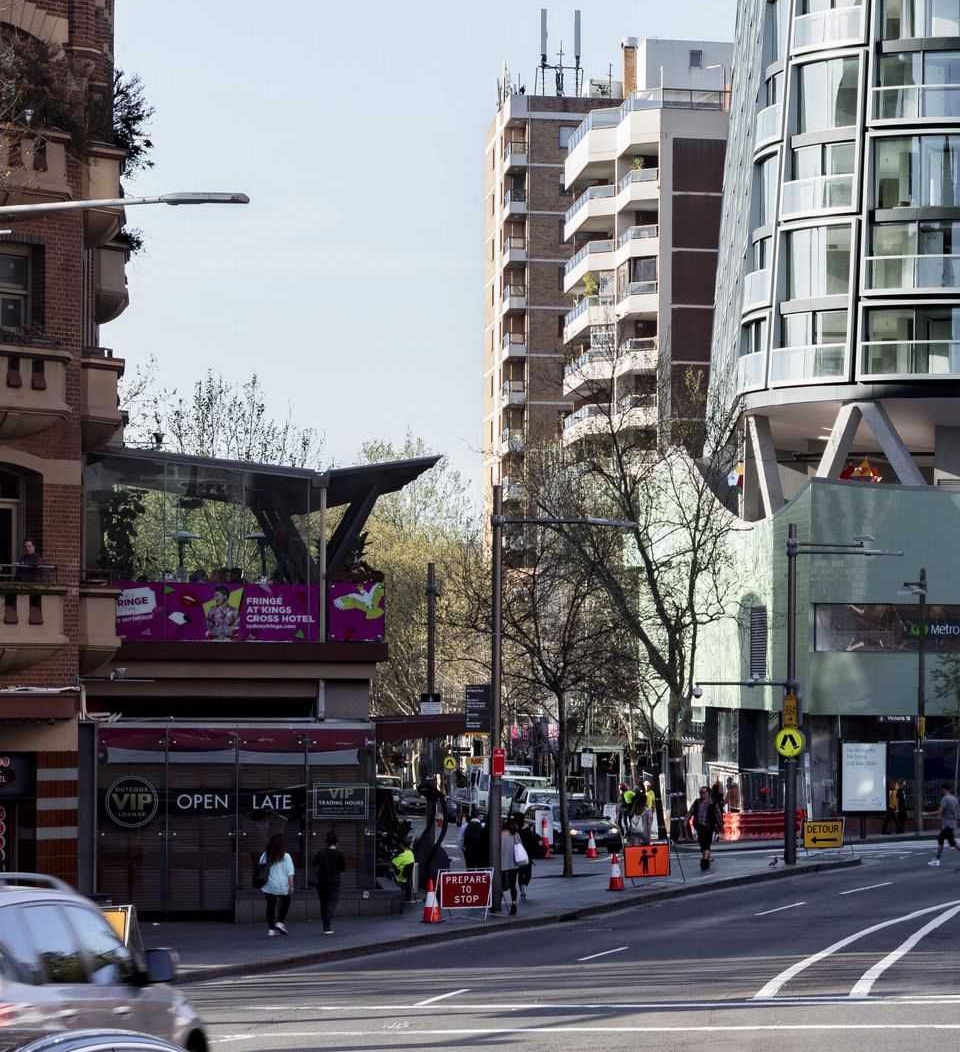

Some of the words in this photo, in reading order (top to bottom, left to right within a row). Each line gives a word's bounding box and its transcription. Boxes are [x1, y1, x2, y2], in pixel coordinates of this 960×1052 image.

[117, 596, 149, 607] RINGE
[246, 597, 283, 605] FRINGE
[246, 606, 258, 614] AT
[261, 606, 292, 614] KINGS
[246, 615, 280, 623] CROSS
[282, 615, 316, 623] HOTEL
[930, 624, 960, 635] Metro
[329, 788, 354, 799] VIP
[111, 793, 153, 811] VIP
[177, 794, 229, 810] OPEN
[252, 794, 292, 810] LATE
[806, 824, 839, 834] DETOUR
[445, 875, 487, 884] PREPARE
[461, 885, 472, 893] TO
[454, 894, 479, 903] STOP
